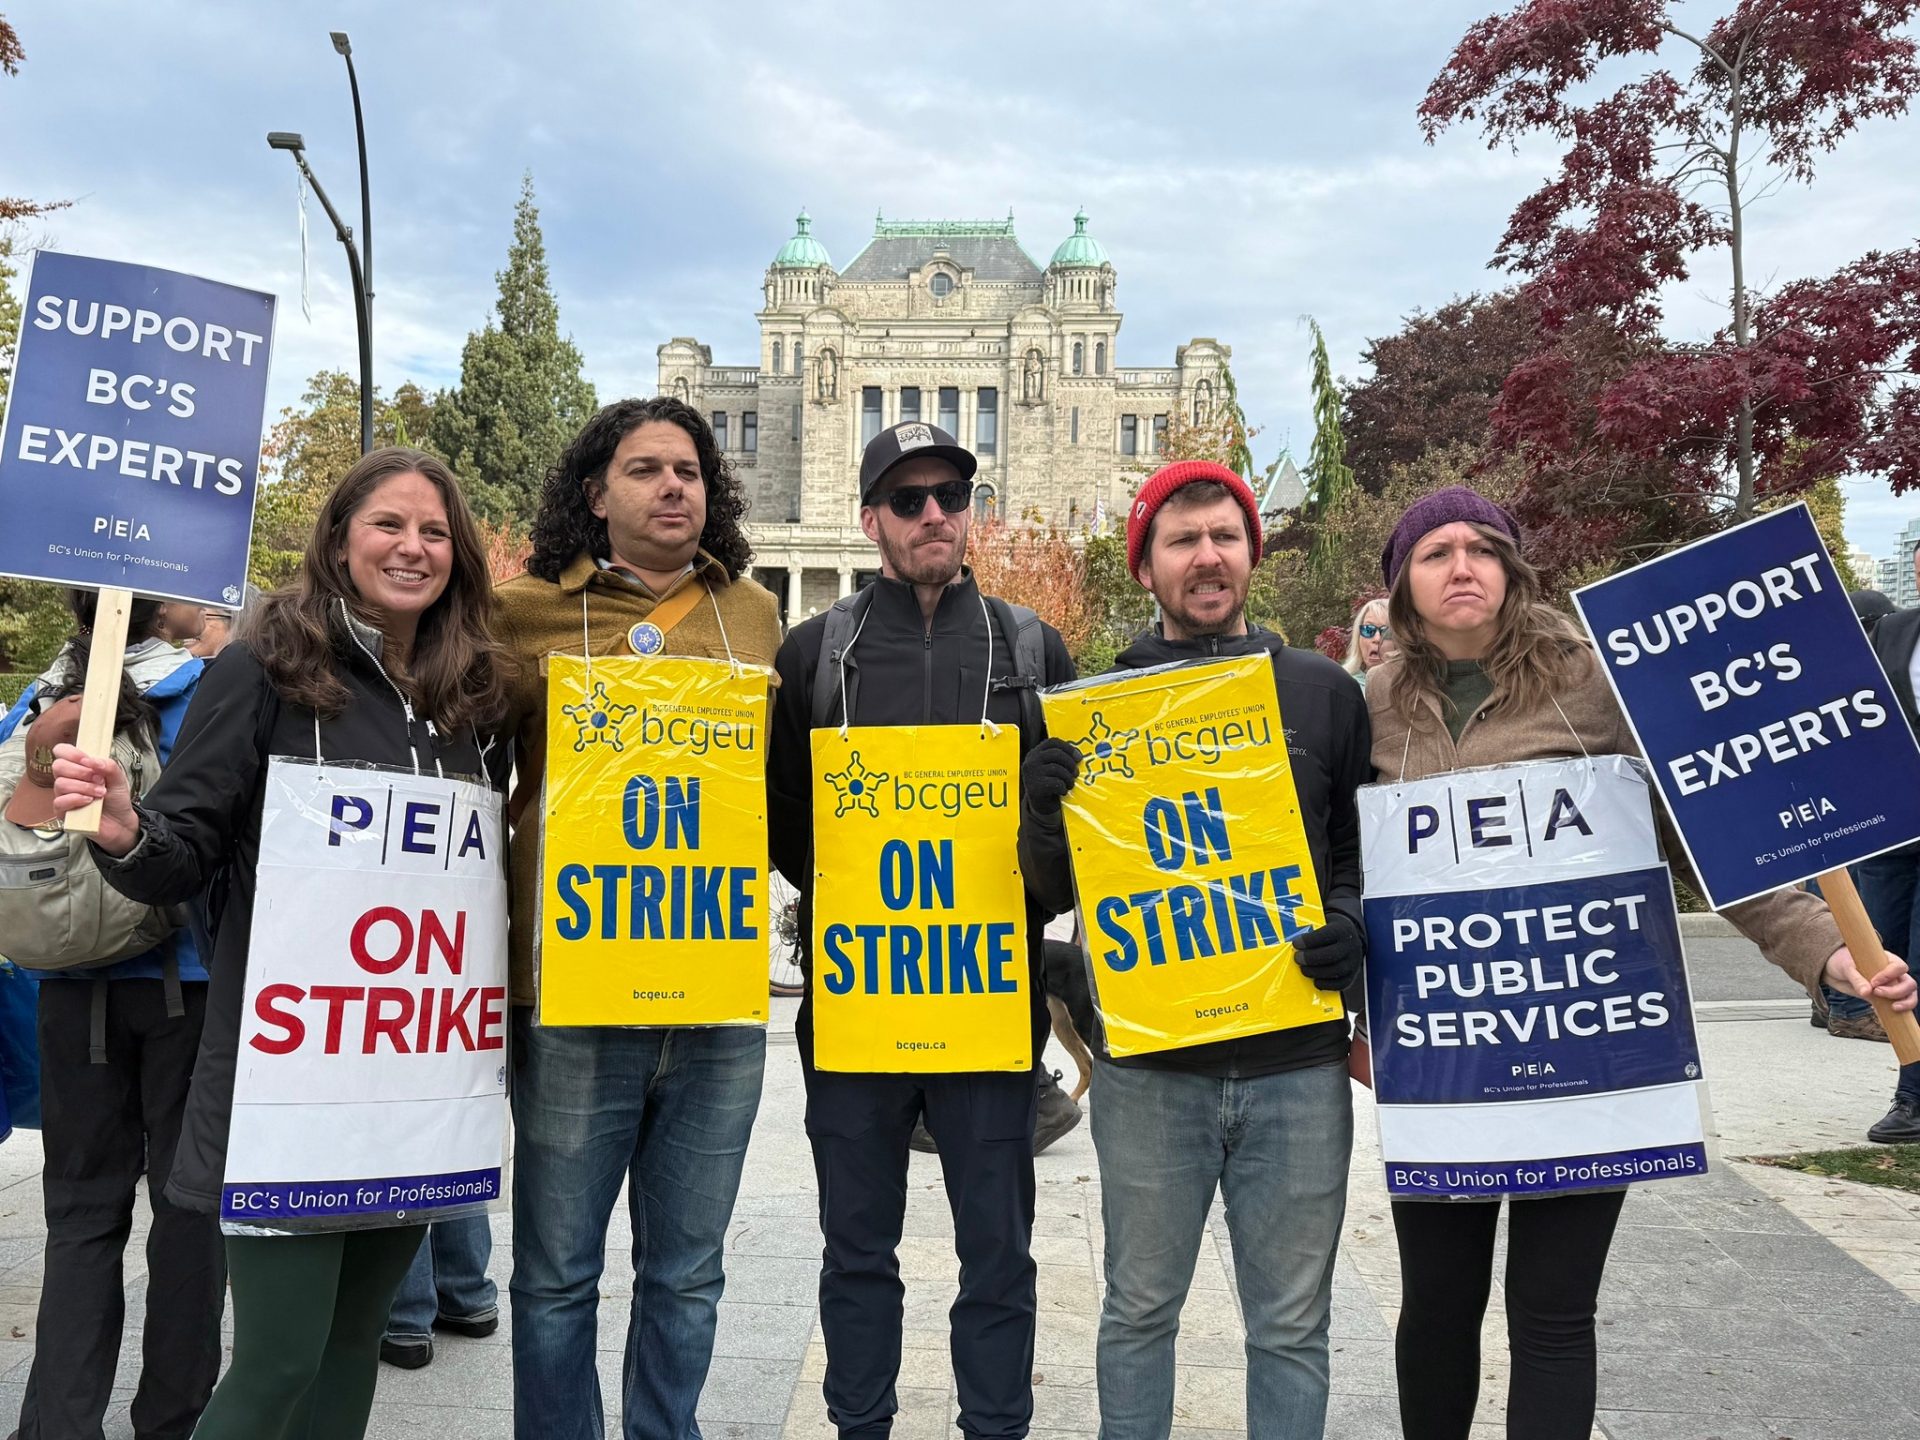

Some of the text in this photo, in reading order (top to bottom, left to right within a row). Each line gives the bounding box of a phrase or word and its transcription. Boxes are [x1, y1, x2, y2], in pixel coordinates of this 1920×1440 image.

[33, 295, 263, 366] SUPPORT
[86, 368, 196, 418] BC'S
[18, 425, 243, 496] EXPERTS
[48, 544, 189, 573] BC's Union for Professionals
[1607, 552, 1823, 666] SUPPORT
[1690, 643, 1802, 711] BC'S
[642, 708, 754, 756] bcgeu
[664, 705, 695, 714] GENERAL
[735, 710, 755, 718] UNION
[1154, 723, 1164, 731] BC
[1165, 715, 1199, 729] GENERAL
[1243, 703, 1266, 715] UNION
[1145, 716, 1272, 766] bcgeu
[1668, 690, 1887, 796] EXPERTS
[894, 775, 1008, 818] bcgeu
[904, 771, 913, 779] BC
[914, 770, 945, 778] GENERAL
[987, 768, 1008, 776] UNION
[622, 774, 701, 850] ON
[1143, 787, 1232, 873] ON
[1755, 813, 1886, 866] BC's Union for Professionals
[879, 838, 955, 911] ON
[556, 863, 758, 941] STRIKE
[1095, 864, 1316, 973] STRIKE
[1393, 894, 1646, 953] PROTECT
[349, 906, 467, 975] ON
[823, 922, 1018, 995] STRIKE
[633, 989, 685, 1001] bcgeu.ca
[1415, 949, 1621, 999] PUBLIC
[248, 983, 505, 1055] STRIKE
[1195, 1002, 1249, 1019] bcgeu.ca
[1396, 991, 1670, 1048] SERVICES
[896, 1040, 946, 1052] bcgeu.ca
[1527, 1083, 1538, 1091] for
[1539, 1079, 1589, 1089] Professionals
[1394, 1152, 1696, 1188] BC's Union for Professionals
[231, 1191, 280, 1210] BC's
[288, 1190, 349, 1208] Union
[356, 1188, 383, 1206] for
